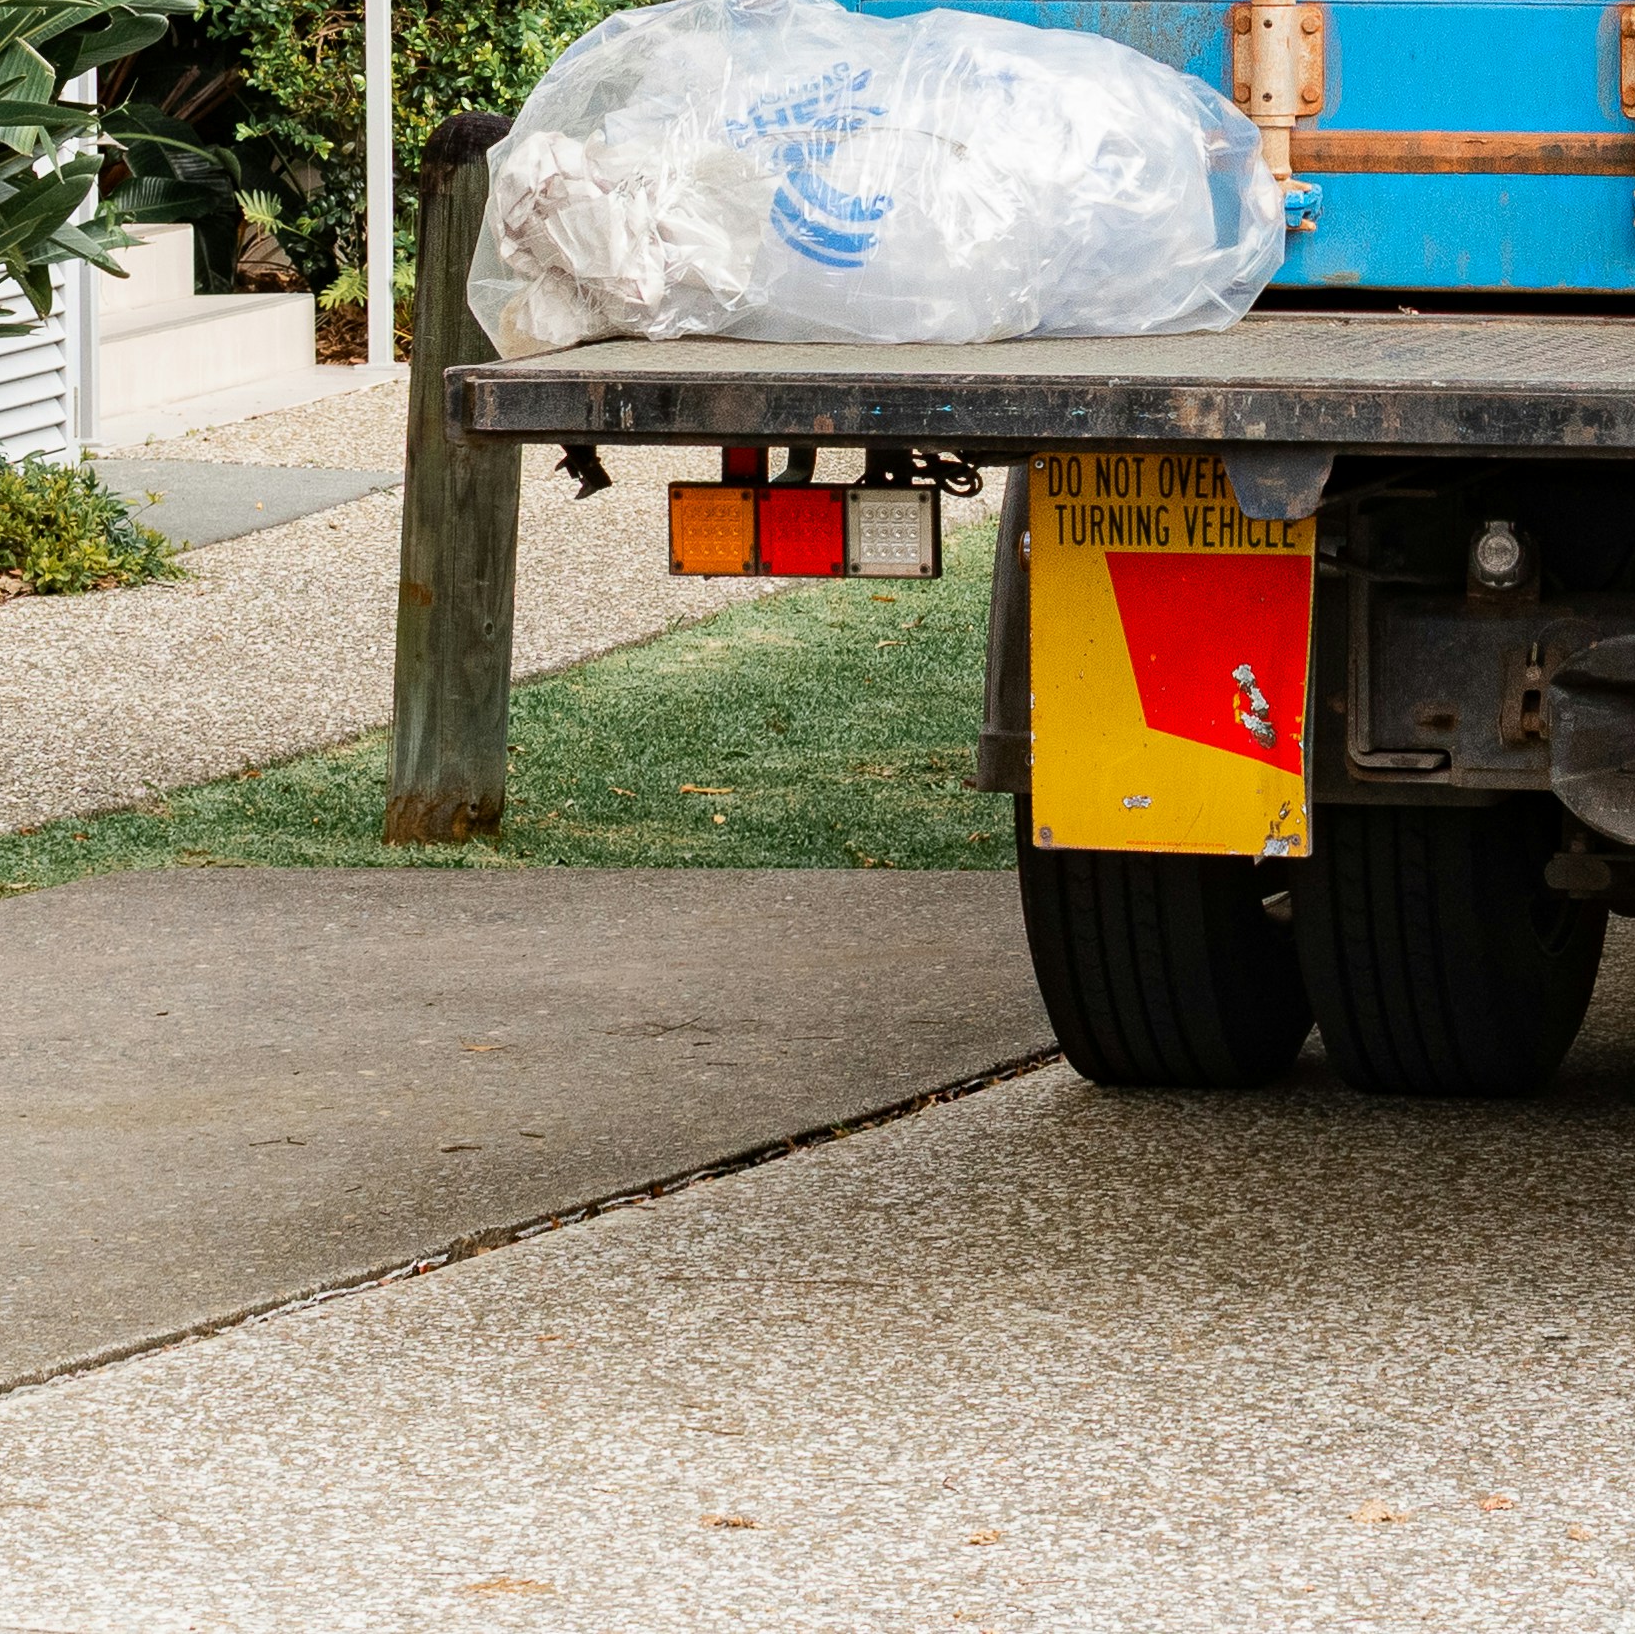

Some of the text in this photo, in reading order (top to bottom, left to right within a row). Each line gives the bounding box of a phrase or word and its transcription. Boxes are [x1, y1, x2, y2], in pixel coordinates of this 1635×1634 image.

[1048, 456, 1083, 499] DO
[1095, 456, 1145, 499] NOT
[1055, 504, 1297, 549] TURNING VEHICLE
